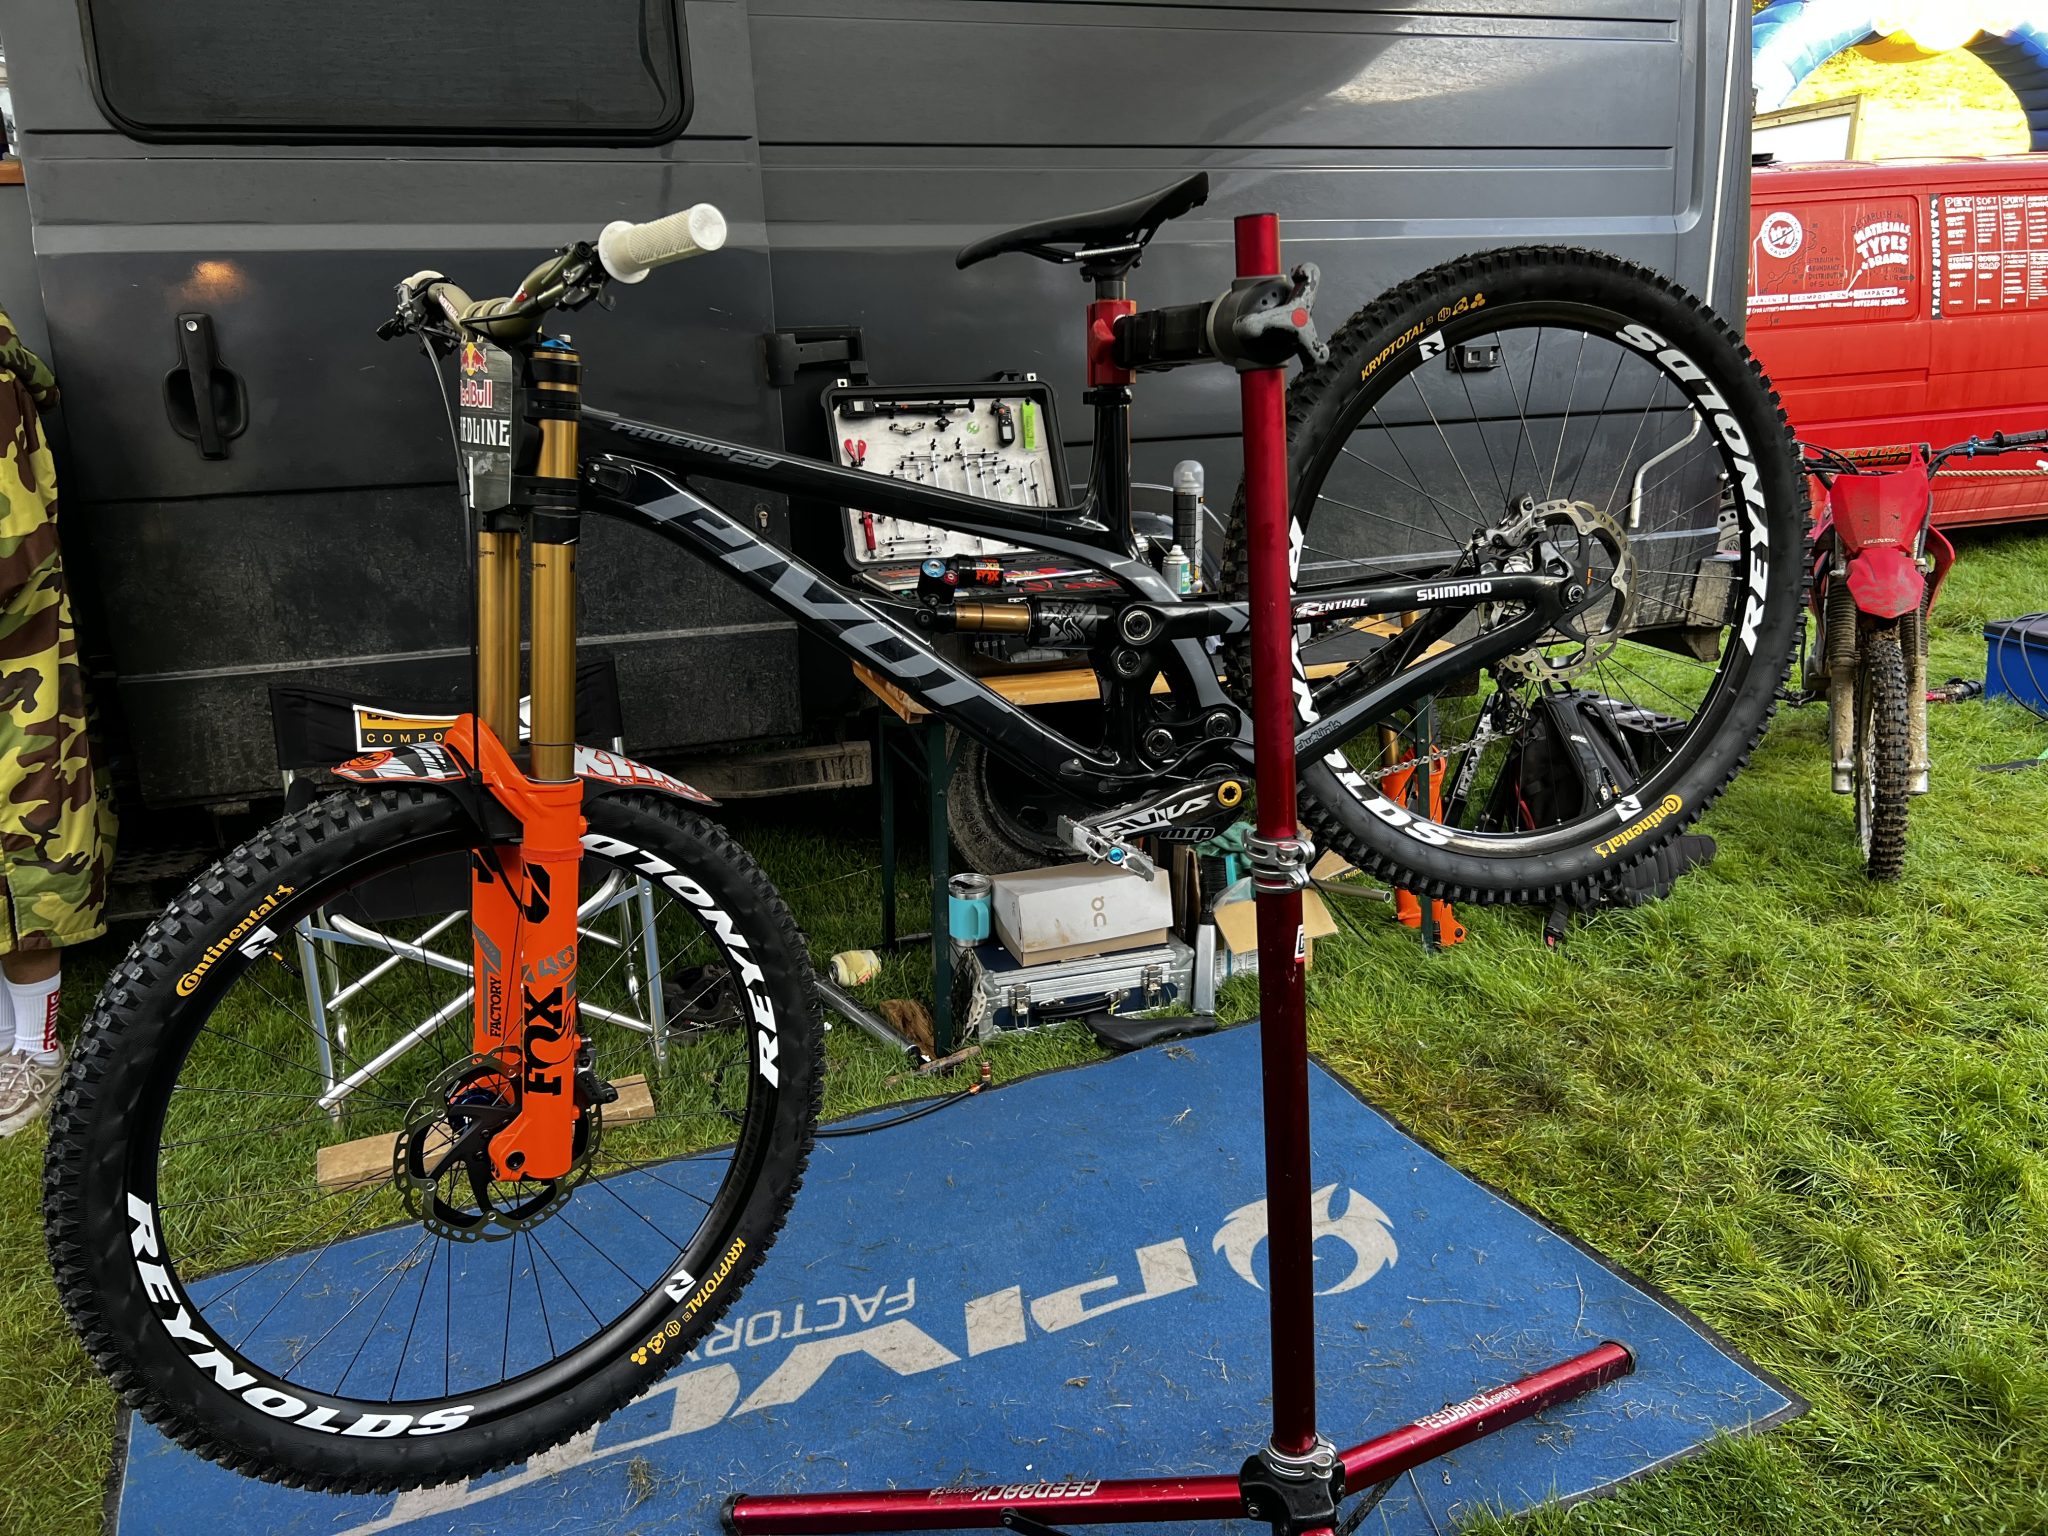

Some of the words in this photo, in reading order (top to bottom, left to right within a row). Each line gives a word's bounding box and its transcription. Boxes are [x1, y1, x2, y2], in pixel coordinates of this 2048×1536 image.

[1976, 197, 1997, 205] SOFT
[1857, 234, 1908, 259] TYPES
[1930, 209, 1941, 269] SURVEY
[1932, 270, 1941, 316] TRASH
[1361, 321, 1427, 382] KRYPTOTAL
[1616, 324, 1769, 656] REYNOLDS
[635, 491, 1012, 714] PIVOT
[1417, 582, 1492, 601] SHIMANO
[366, 732, 443, 743] COMPO
[1605, 794, 1683, 854] Continental
[176, 894, 280, 997] Continental
[579, 834, 779, 1089] REYNOLD
[489, 976, 502, 1038] FACTORY
[523, 985, 576, 1098] FOX
[685, 1237, 746, 1314] KRYPTOTAL
[127, 1192, 475, 1438] REYNOLDS
[1414, 1395, 1494, 1430] FEEDBACK
